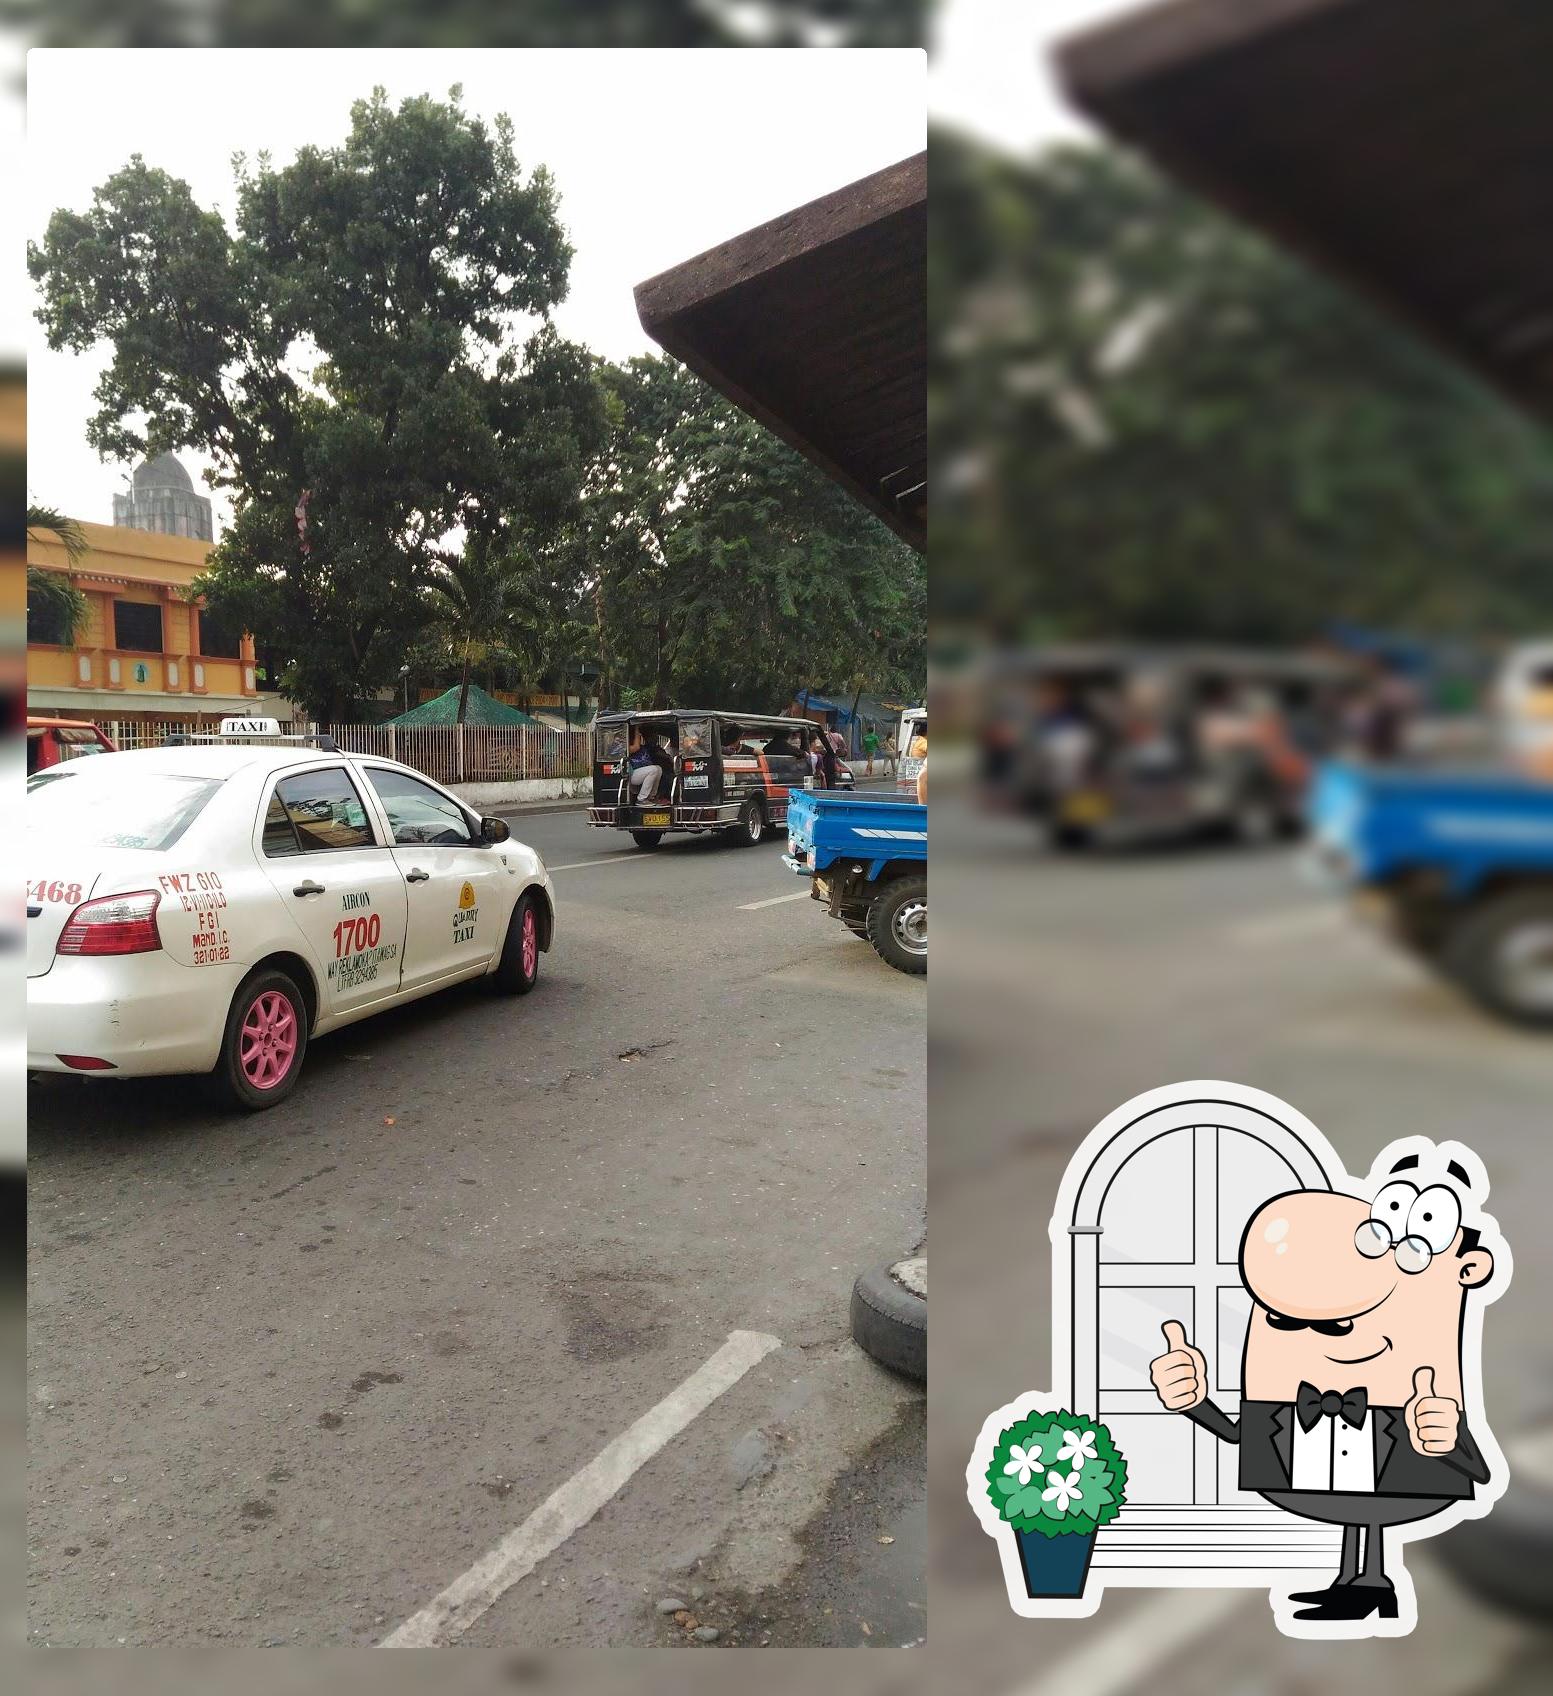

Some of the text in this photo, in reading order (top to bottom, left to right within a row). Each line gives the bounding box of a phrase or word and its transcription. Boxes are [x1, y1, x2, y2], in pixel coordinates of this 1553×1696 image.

[228, 721, 264, 732] TAXI
[159, 873, 196, 894] FWZ
[342, 891, 370, 911] AIRCON
[333, 913, 381, 958] 1700
[454, 926, 474, 943] TAXI
